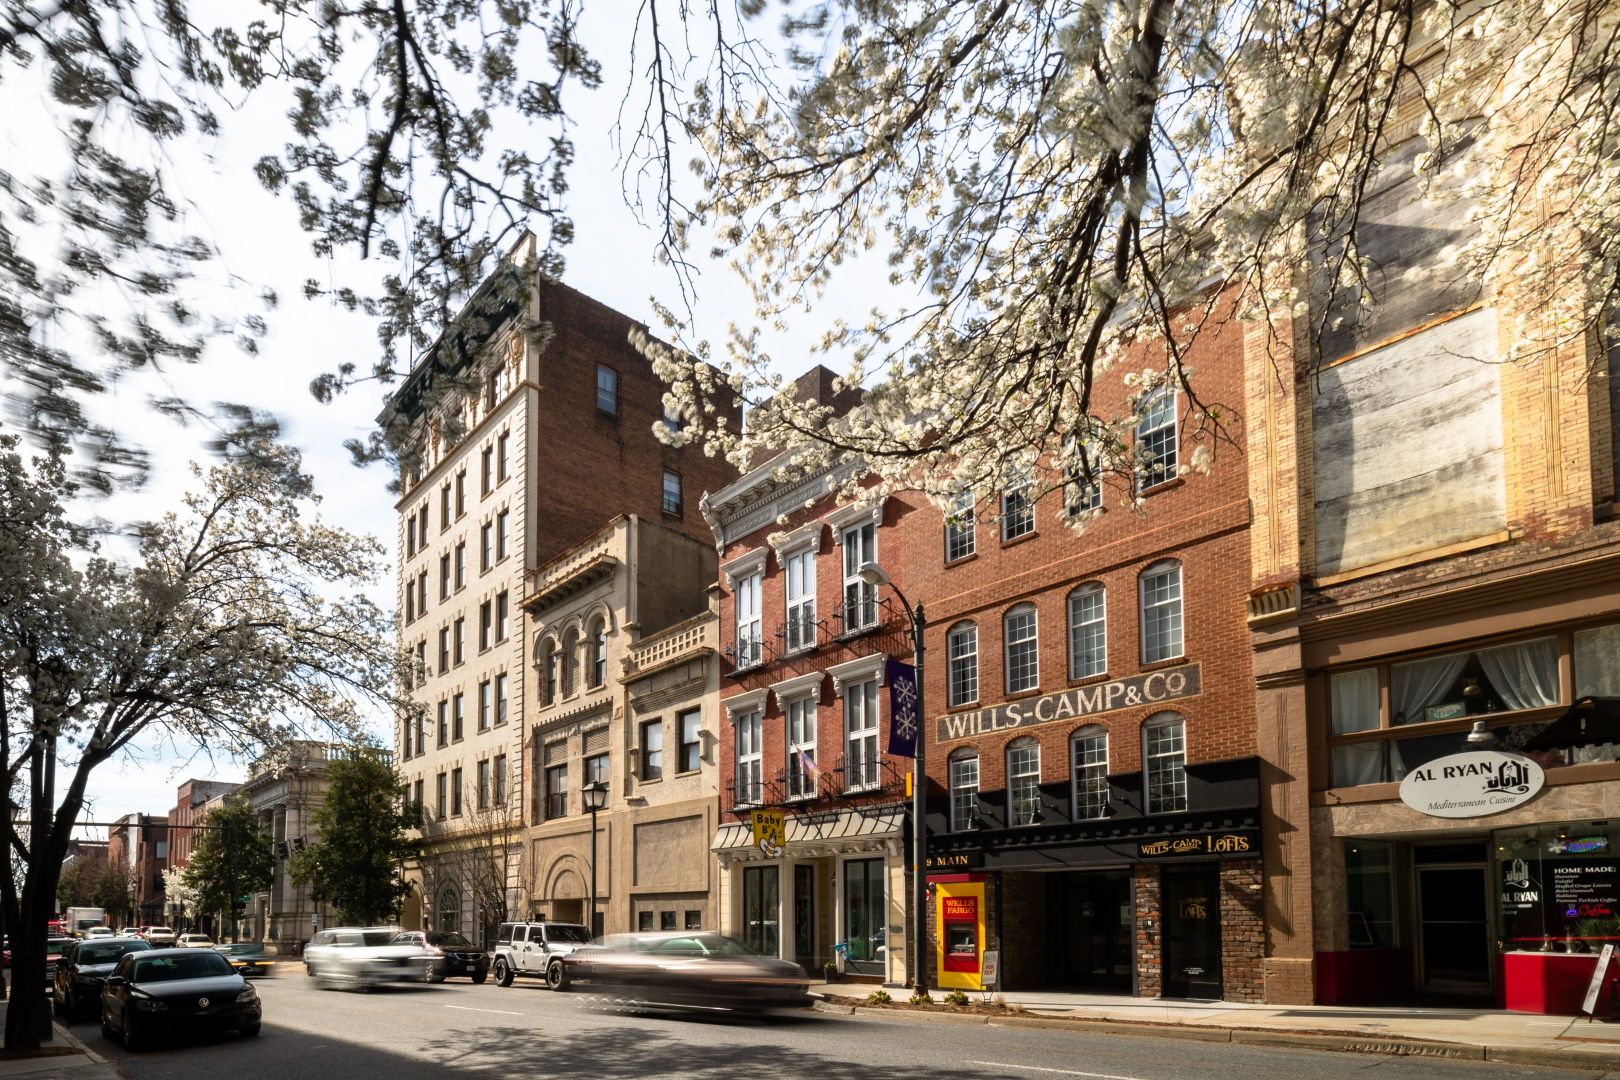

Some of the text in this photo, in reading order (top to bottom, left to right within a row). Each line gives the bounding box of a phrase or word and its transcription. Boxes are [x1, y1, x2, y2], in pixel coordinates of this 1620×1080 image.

[1413, 761, 1493, 782] AL RYAN
[1427, 795, 1517, 811] Mediterranean Cuisine
[756, 813, 781, 827] Baby
[1141, 838, 1202, 855] WILLS-CAMP
[937, 855, 969, 866] MAIN
[946, 899, 975, 907] WELLS
[1501, 891, 1538, 902] AL RYAN
